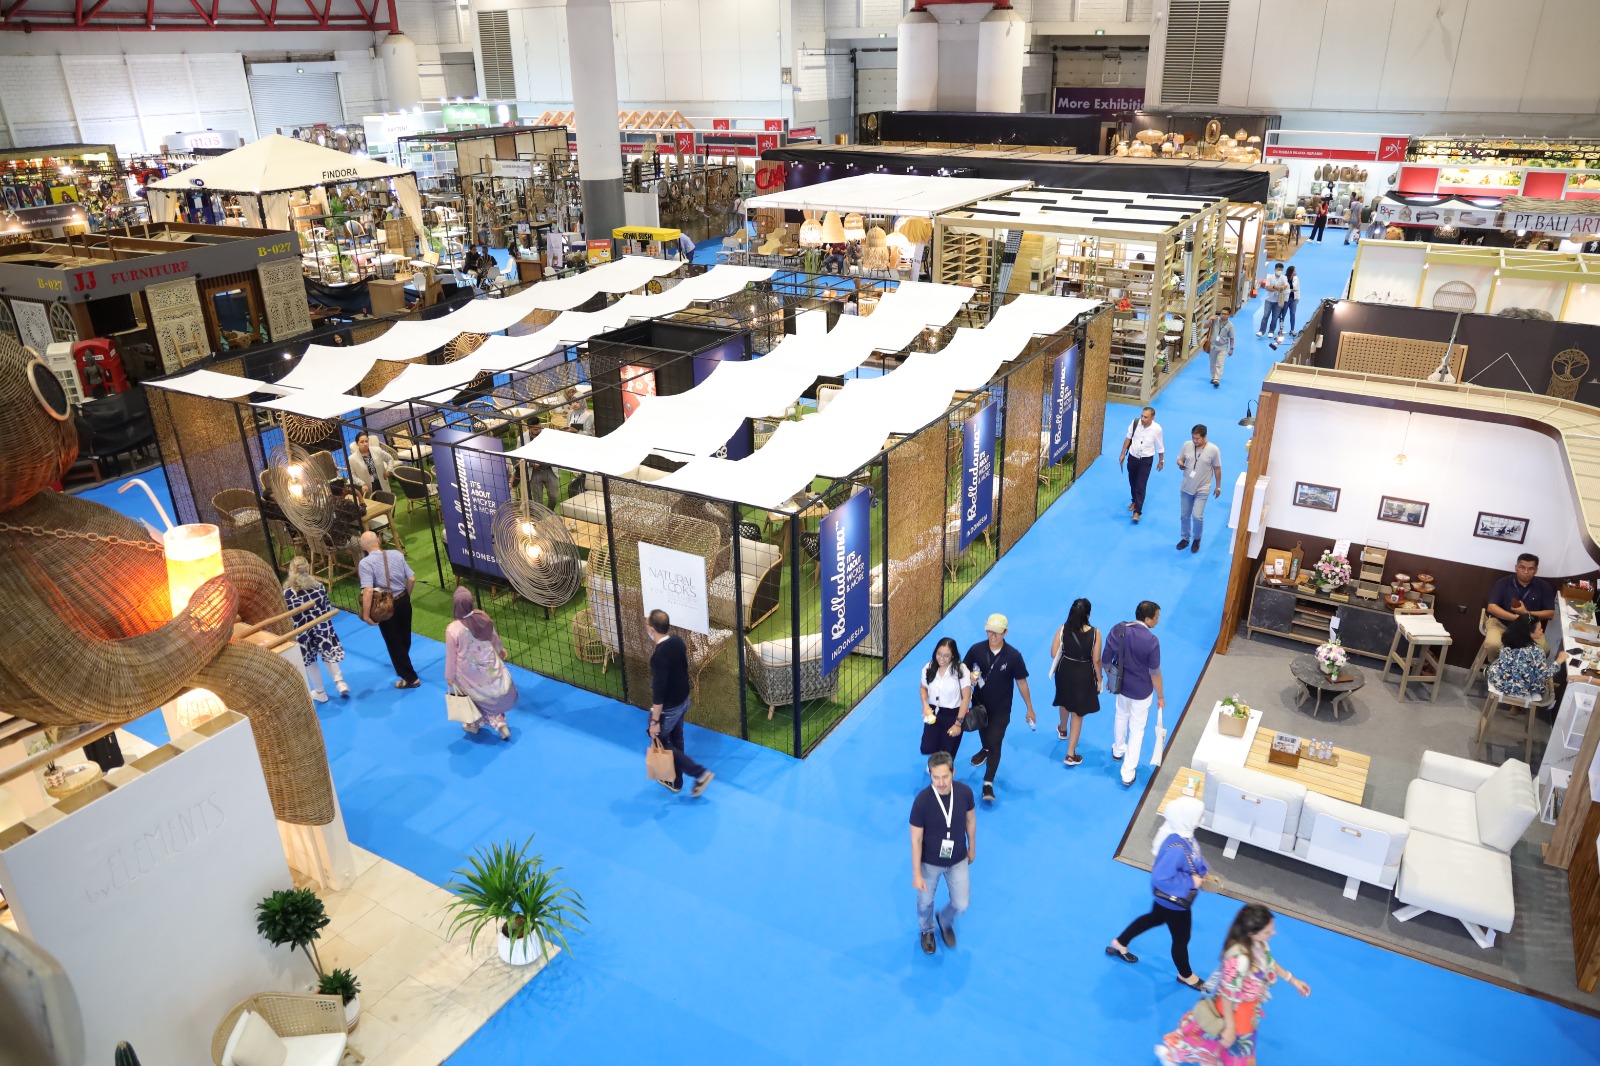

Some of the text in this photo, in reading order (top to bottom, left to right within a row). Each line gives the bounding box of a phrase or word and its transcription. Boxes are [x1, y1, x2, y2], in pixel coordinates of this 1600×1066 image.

[1058, 98, 1090, 109] More
[322, 168, 358, 179] FINDORA
[257, 242, 292, 257] B-027
[37, 278, 63, 291] B-027
[73, 260, 190, 292] JJ FURNITURE
[471, 488, 491, 499] ABOUT
[461, 547, 503, 564] INDONES
[846, 554, 862, 574] ABOUT
[648, 566, 693, 587] NATURAL
[846, 562, 865, 582] WICKER
[851, 571, 865, 589] MORE
[662, 580, 697, 598] LOOKS
[831, 625, 865, 661] INDONESIA
[107, 791, 225, 890] ELEMENTS
